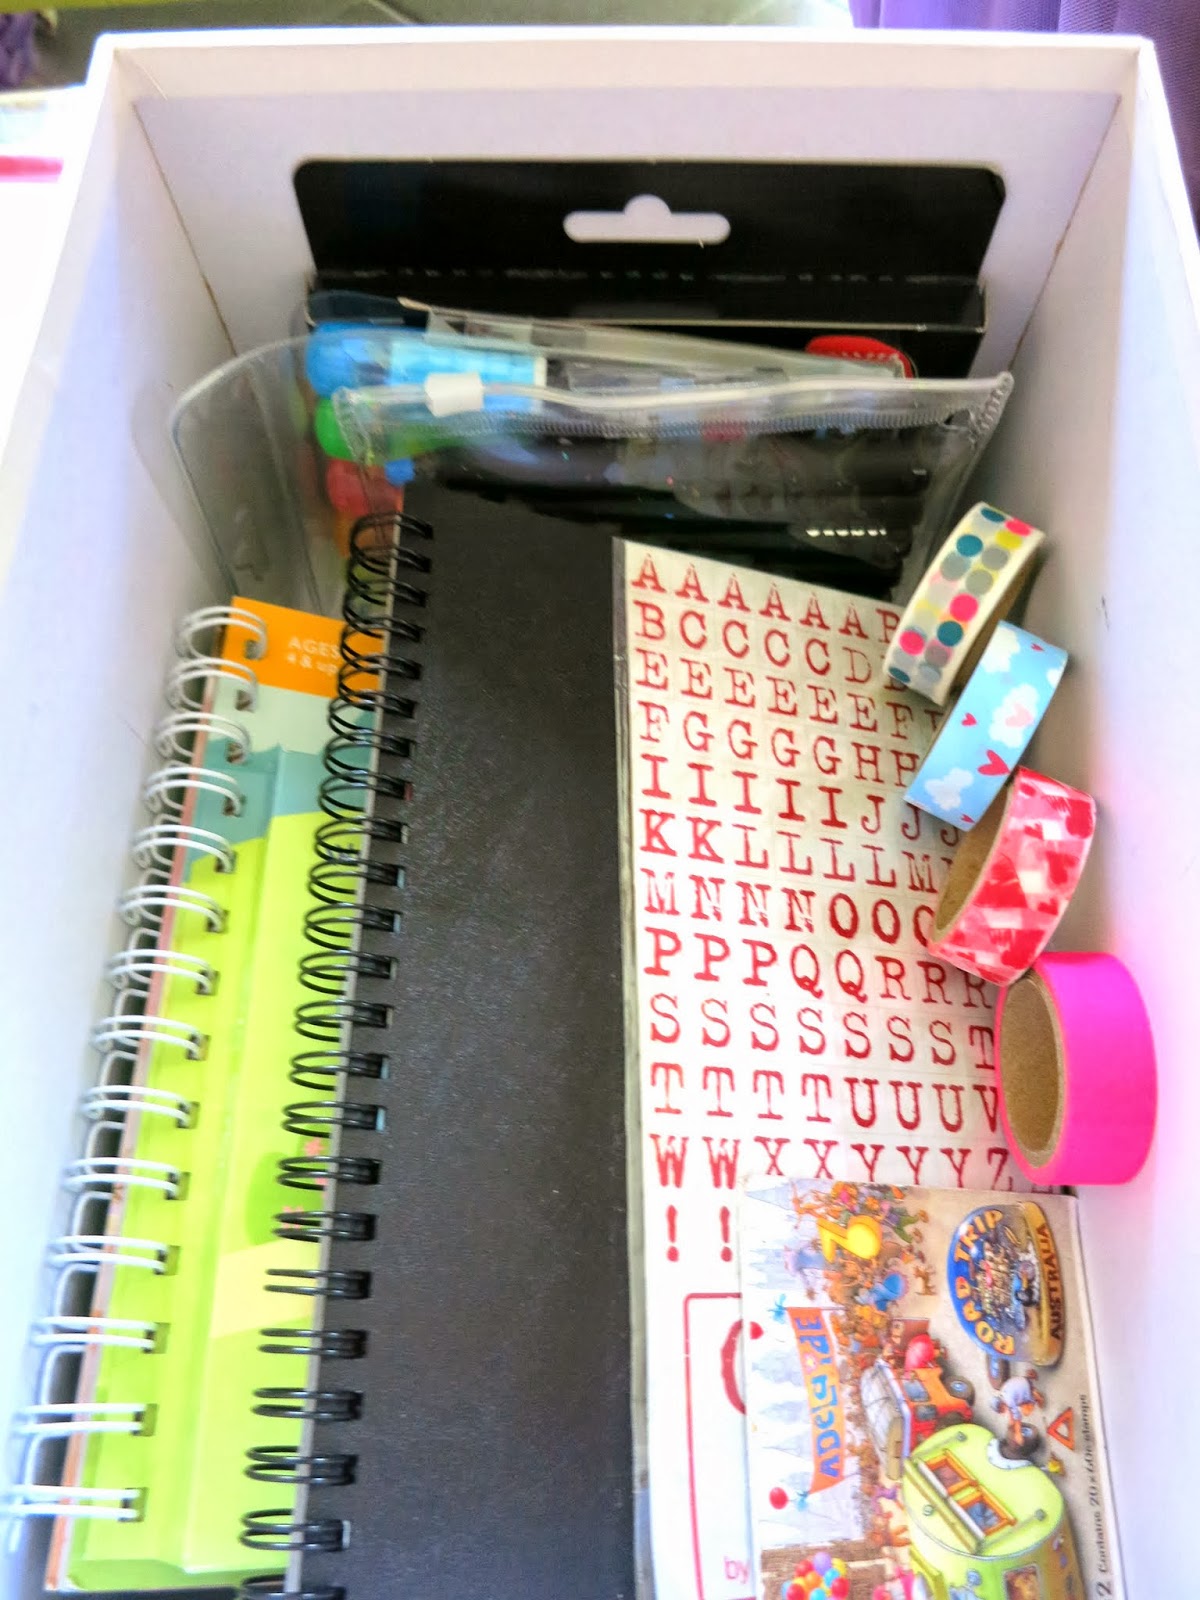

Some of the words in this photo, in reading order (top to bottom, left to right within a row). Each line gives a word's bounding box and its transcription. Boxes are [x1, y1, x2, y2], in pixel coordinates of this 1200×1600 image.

[631, 553, 667, 594] A
[675, 562, 710, 604] A
[717, 572, 752, 614] A
[758, 582, 793, 623] A
[799, 592, 832, 632] A
[838, 602, 869, 640] A
[288, 636, 341, 659] AGES
[633, 599, 667, 642] B
[679, 609, 708, 651] C
[722, 618, 750, 660] C
[764, 628, 792, 669] C
[804, 637, 832, 677] C
[845, 646, 873, 685] D
[635, 648, 670, 692] E
[680, 657, 714, 701] E
[723, 667, 757, 710] E
[766, 675, 799, 718] E
[806, 683, 839, 726] E
[848, 691, 879, 733] E
[886, 702, 914, 740] F
[637, 700, 671, 744] F
[683, 710, 716, 753] G
[727, 719, 759, 761] G
[770, 727, 802, 769] G
[812, 735, 844, 777] G
[852, 741, 885, 785] H
[638, 807, 678, 858] K
[686, 815, 725, 865] K
[731, 823, 770, 871] L
[776, 830, 814, 877] L
[820, 837, 857, 884] L
[863, 844, 899, 890] L
[902, 851, 938, 895] M
[860, 793, 885, 836] J
[639, 867, 681, 917] M
[688, 873, 726, 922] N
[735, 881, 773, 929] N
[780, 887, 817, 935] N
[644, 926, 683, 977] P
[693, 932, 731, 983] P
[742, 938, 779, 988] P
[789, 943, 824, 1000] Q
[834, 949, 870, 1005] Q
[875, 955, 912, 1001] R
[917, 960, 952, 1006] R
[650, 992, 682, 1045] S
[700, 998, 732, 1049] S
[750, 1002, 781, 1052] S
[797, 1006, 828, 1057] S
[842, 1011, 873, 1060] S
[885, 1015, 916, 1064] S
[929, 1019, 957, 1067] S
[649, 1062, 685, 1115] T
[701, 1066, 736, 1118] T
[752, 1070, 785, 1120] T
[800, 1073, 832, 1124] T
[843, 1077, 880, 1130] U
[888, 1080, 923, 1132] U
[931, 1083, 965, 1134] U
[649, 1134, 689, 1189] W
[701, 1136, 741, 1190] W
[954, 1209, 1004, 1263] TRIP
[955, 1276, 1016, 1356] ROAD
[1035, 1224, 1062, 1341] AUSTRALIA
